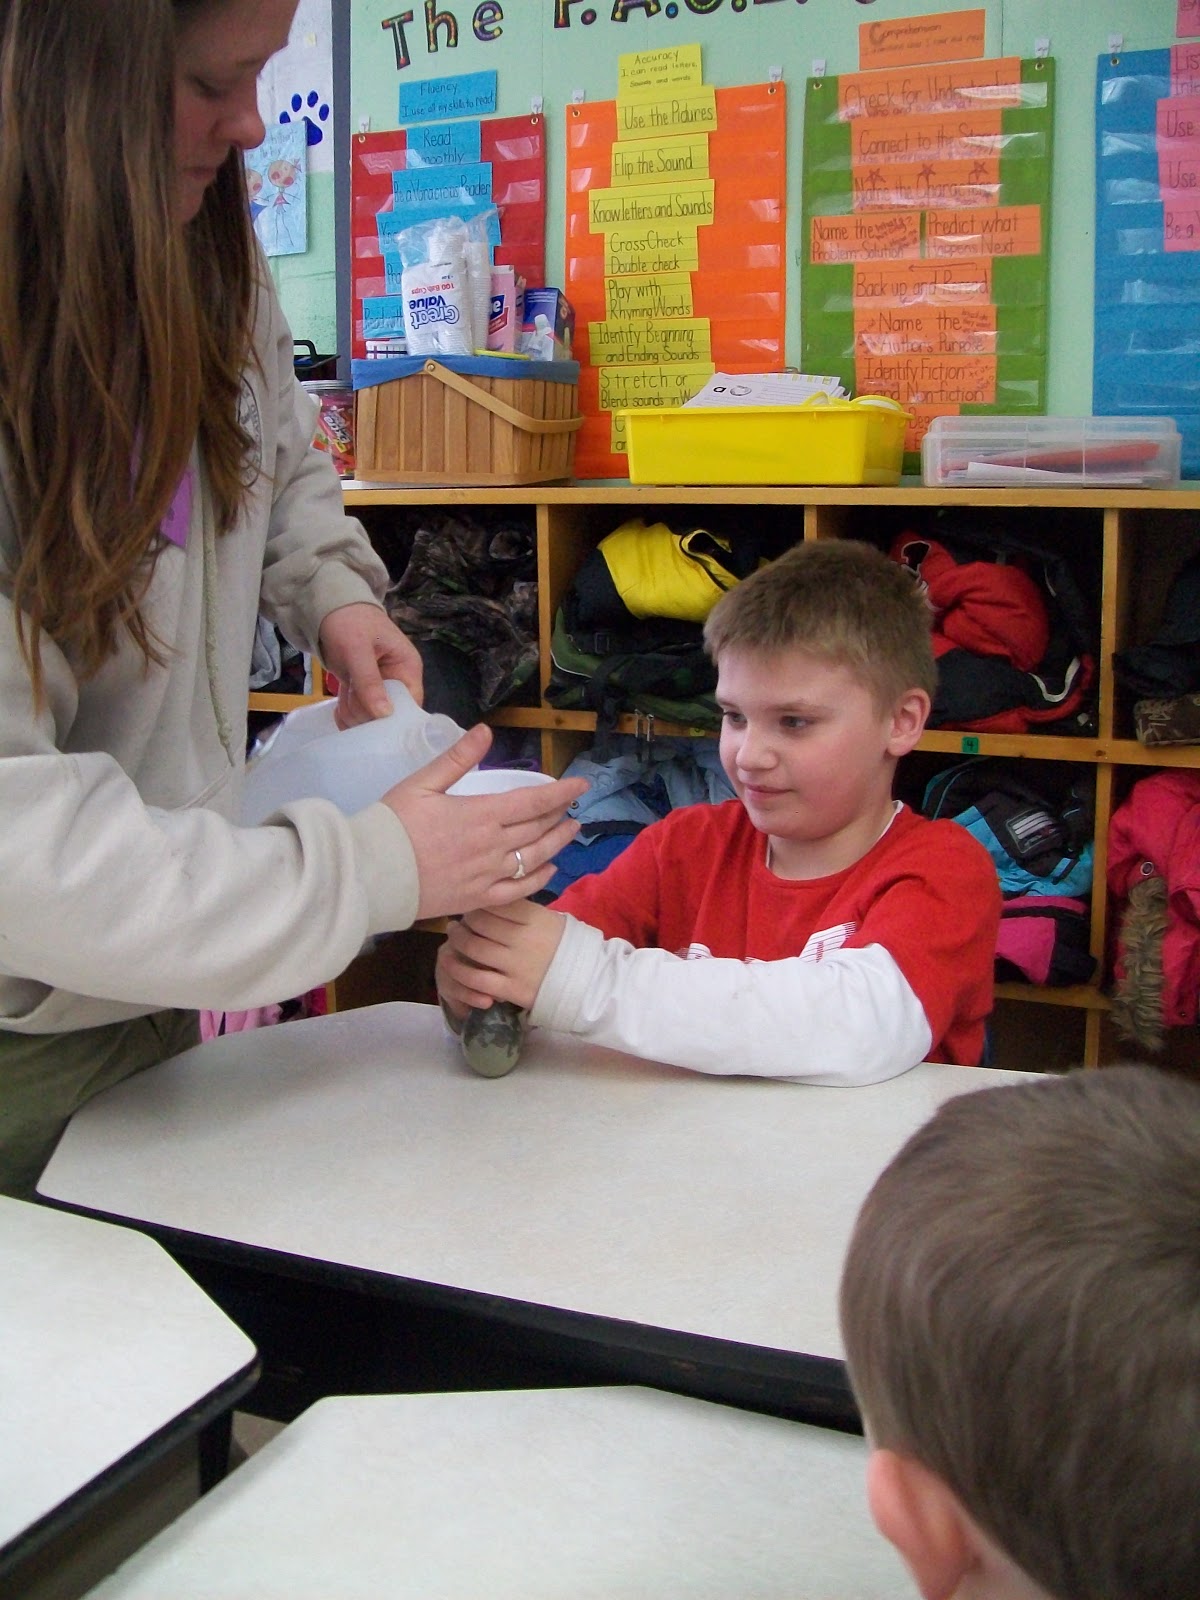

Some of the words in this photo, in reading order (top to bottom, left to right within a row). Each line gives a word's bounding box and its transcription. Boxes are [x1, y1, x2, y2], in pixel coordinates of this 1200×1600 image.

[381, 0, 504, 70] The
[634, 50, 679, 65] Accuracy
[631, 68, 646, 76] can
[650, 64, 668, 72] read
[420, 82, 458, 96] Fluency
[844, 83, 894, 109] Check
[902, 78, 921, 105] for
[402, 105, 408, 117] I
[411, 107, 424, 116] use
[476, 90, 493, 107] read
[624, 106, 646, 130] Use
[650, 107, 669, 126] the
[1166, 109, 1194, 137] Use
[423, 127, 451, 148] Read
[859, 129, 909, 155] Connect
[917, 132, 932, 150] to
[413, 147, 465, 166] moothly
[614, 151, 634, 180] Flip
[637, 156, 653, 174] the
[656, 147, 693, 172] Sound
[1169, 161, 1197, 189] Use
[591, 199, 621, 223] Know
[621, 197, 653, 220] letters
[653, 197, 674, 217] and
[674, 191, 712, 216] Sounds
[813, 217, 849, 241] Name
[855, 218, 875, 240] the
[928, 211, 975, 235] Predict
[981, 210, 1017, 233] what
[1165, 212, 1181, 240] Be
[610, 233, 646, 253] Cross
[646, 230, 683, 250] Check
[980, 235, 1015, 254] Next
[611, 256, 648, 274] Double
[652, 255, 680, 272] check
[608, 279, 632, 301] Play
[636, 278, 661, 297] with
[856, 272, 887, 297] Back
[409, 294, 447, 310] Value
[610, 299, 653, 320] Rhyming
[653, 297, 691, 318] Words
[410, 304, 460, 330] Great
[879, 310, 923, 333] Name
[936, 309, 962, 331] the
[597, 322, 641, 346] Identify
[646, 321, 695, 347] Beginning
[605, 350, 625, 363] and
[626, 344, 659, 363] Ending
[663, 345, 700, 362] Sounds
[600, 368, 669, 390] Stretch
[675, 377, 689, 387] or
[864, 357, 918, 381] Identify
[921, 357, 966, 381] Fiction
[601, 389, 628, 409] Blend
[632, 391, 665, 408] sounds
[966, 740, 975, 751] 4
